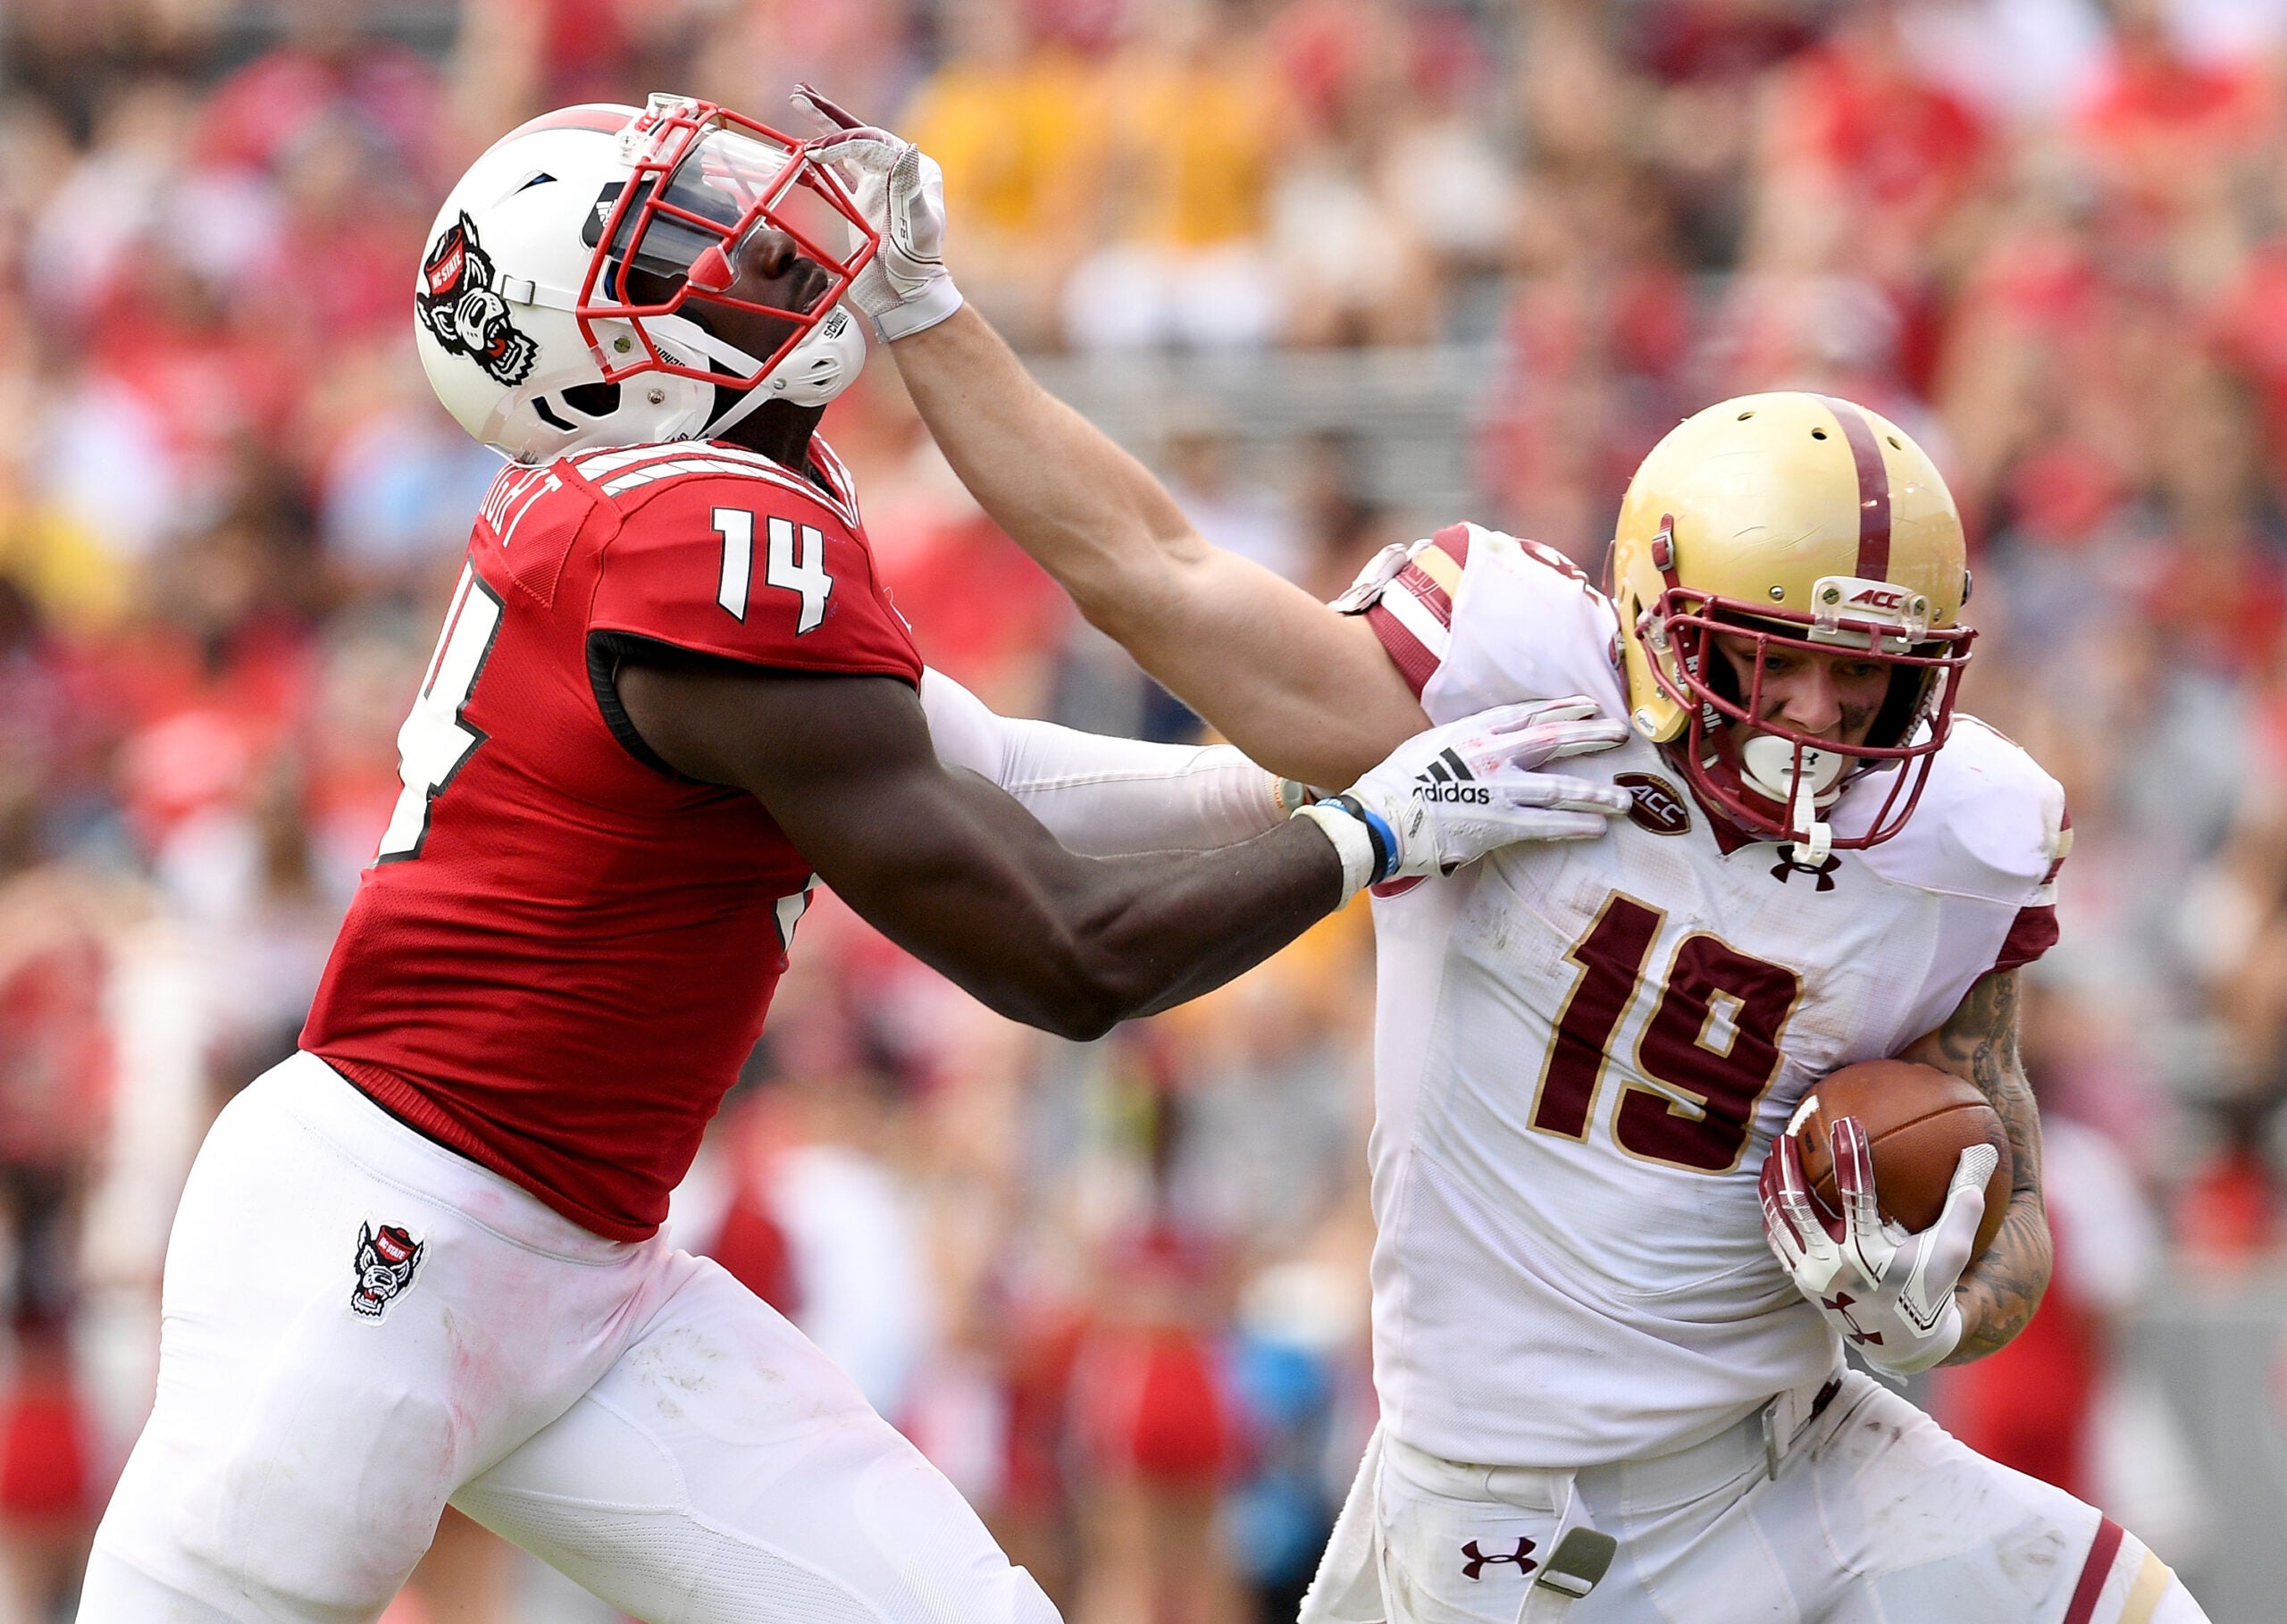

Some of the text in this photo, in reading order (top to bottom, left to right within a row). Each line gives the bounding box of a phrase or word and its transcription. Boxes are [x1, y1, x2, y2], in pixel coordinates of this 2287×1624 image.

[441, 249, 463, 282] STATE
[711, 506, 835, 639] 14
[1848, 589, 1904, 610] ACC
[1628, 785, 1687, 824] ACC
[1526, 888, 1804, 1175] 19
